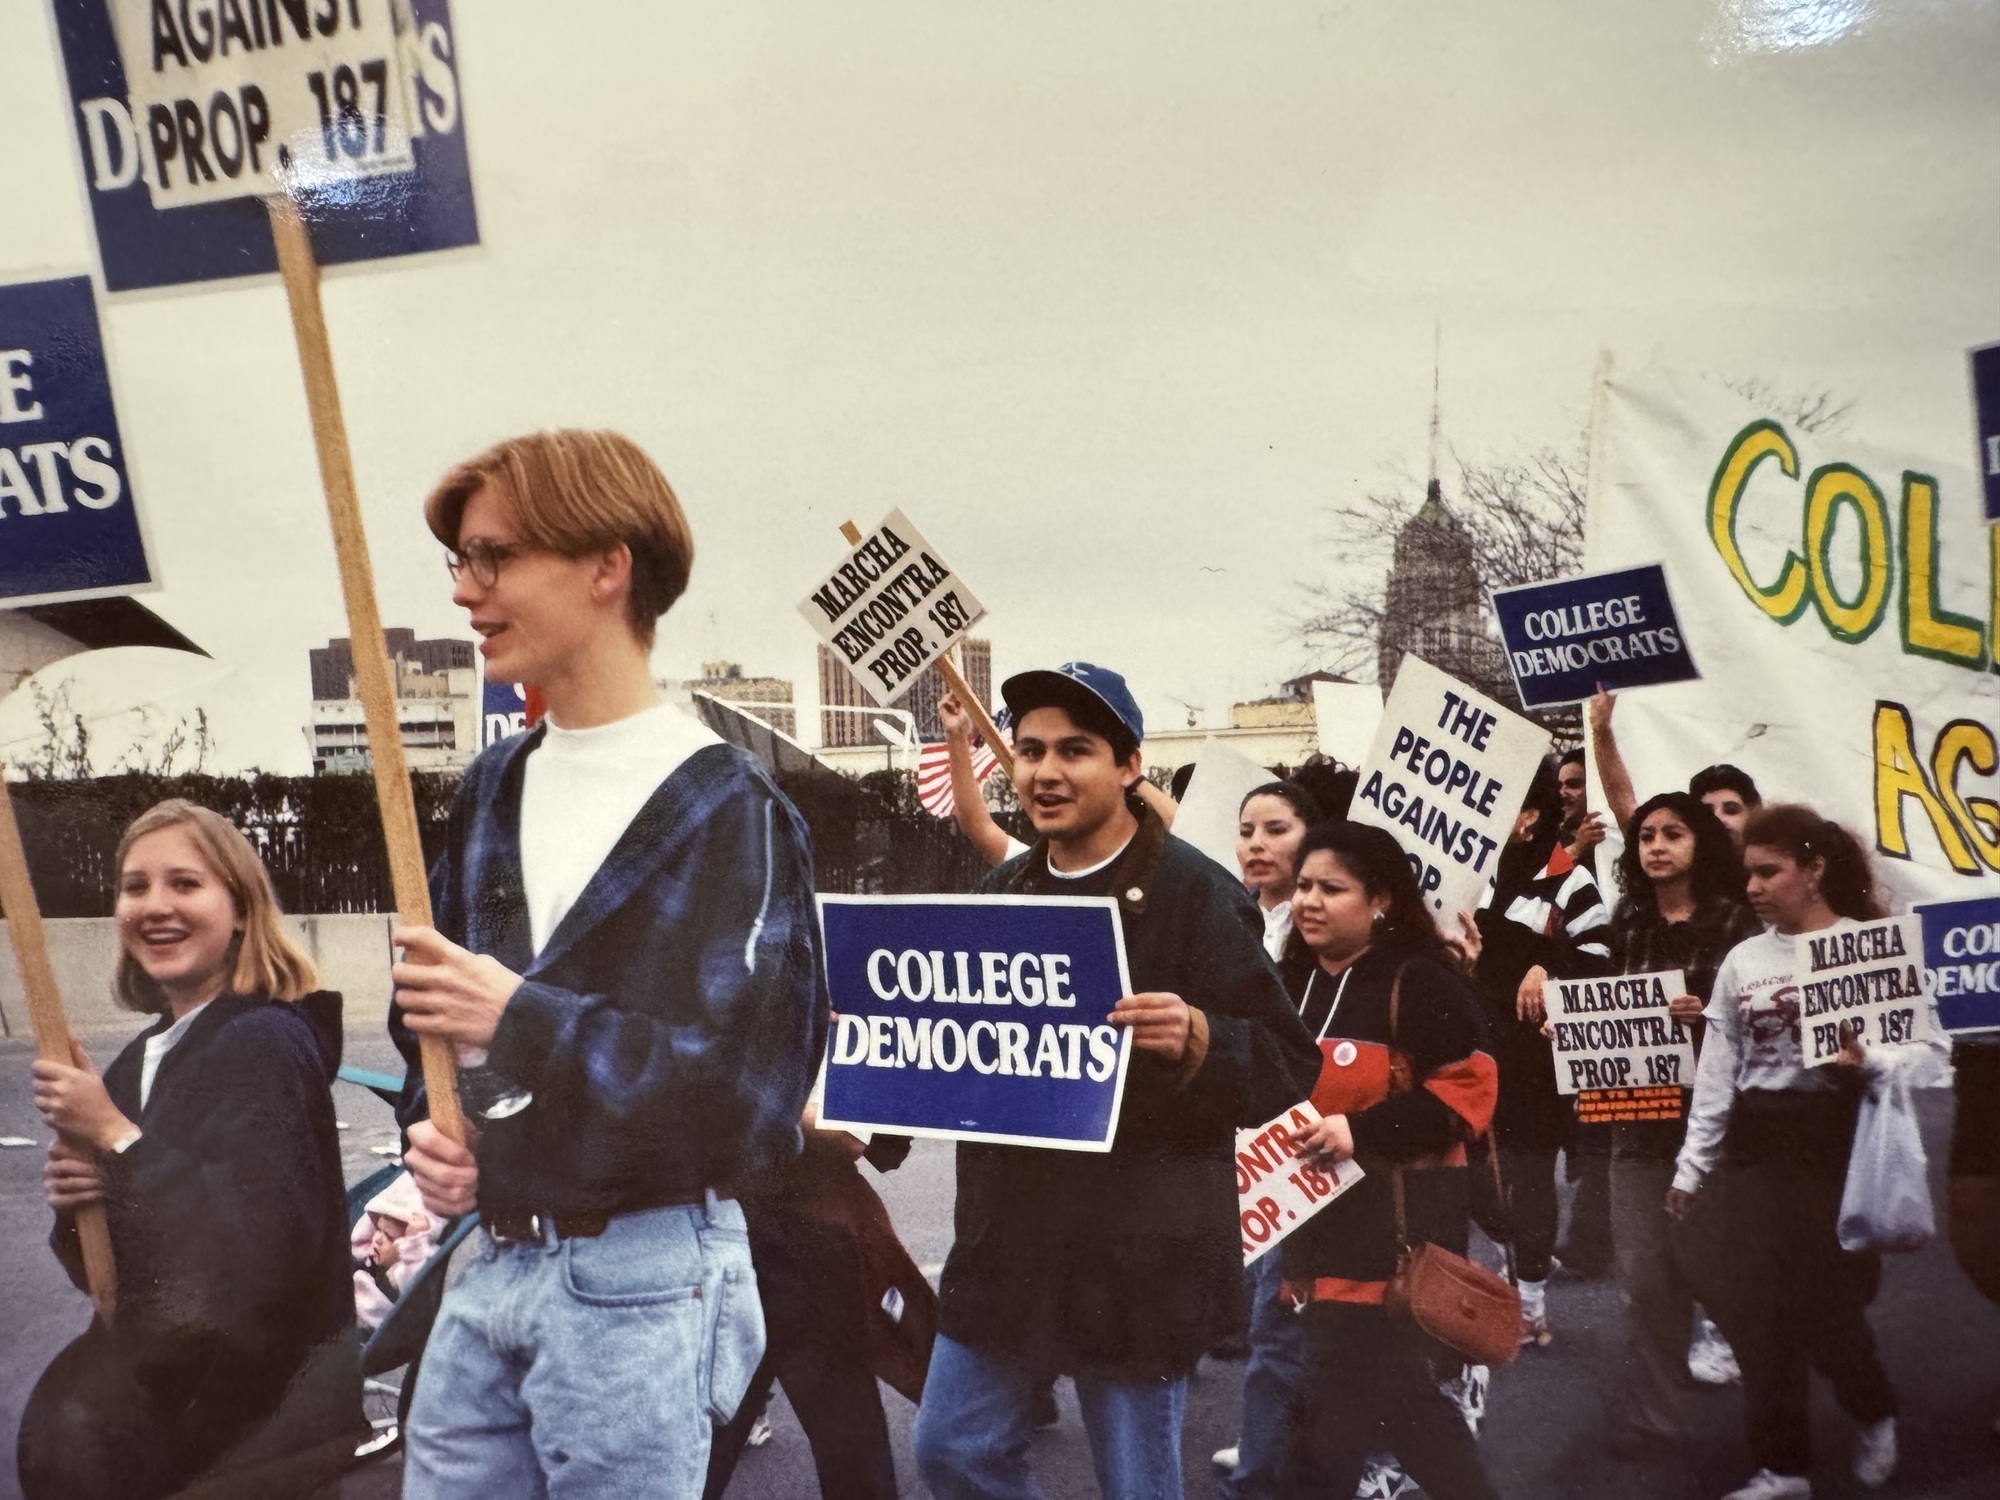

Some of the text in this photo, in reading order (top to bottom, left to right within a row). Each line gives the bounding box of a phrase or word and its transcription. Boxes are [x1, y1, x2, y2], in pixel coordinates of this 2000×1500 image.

[148, 59, 388, 189] PROP. 187
[811, 526, 911, 623] MARCHA
[1706, 418, 2000, 676] COL
[832, 552, 950, 665] ENCONTRA
[1524, 595, 1646, 641] COLLEGE
[868, 591, 970, 692] PROP. 187
[1513, 627, 1680, 678] DEMOCRATS
[1437, 690, 1497, 752] THE
[1390, 726, 1503, 818] PEOPLE
[1359, 770, 1498, 873] AGAINST
[866, 948, 1076, 1008] COLLEGE
[1809, 924, 1907, 973] MARCHA
[1560, 977, 1669, 1014] MARCHA
[1802, 964, 1922, 1018] ENCONTRA
[831, 1013, 1118, 1083] DEMOCRATS
[1554, 1016, 1688, 1052] ENCONTRA
[1878, 1008, 1914, 1045] 187
[1568, 1053, 1680, 1089] PROP. 187
